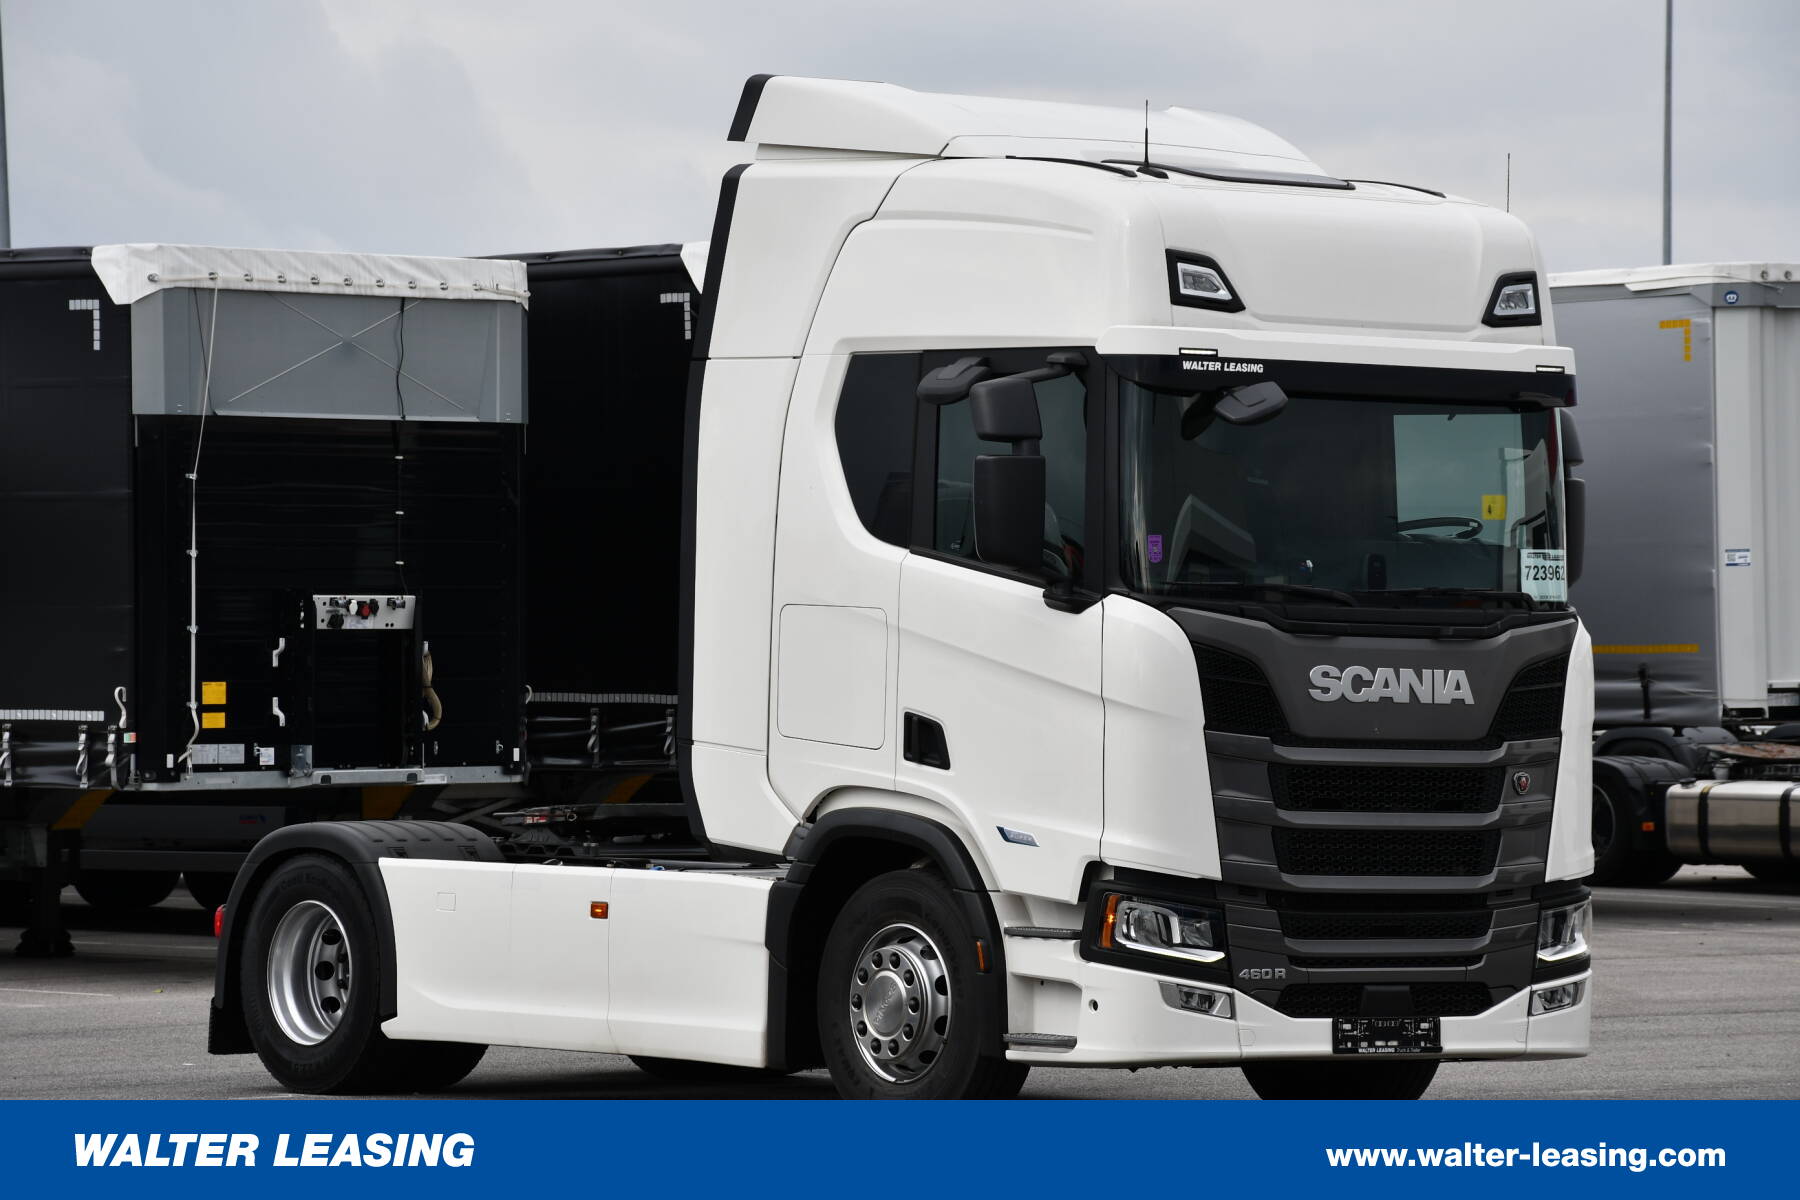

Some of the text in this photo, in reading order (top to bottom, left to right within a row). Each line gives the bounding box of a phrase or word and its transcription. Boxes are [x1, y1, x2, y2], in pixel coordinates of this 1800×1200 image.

[1182, 360, 1264, 373] WALTER LEASING
[1308, 664, 1475, 705] SCANIA
[1238, 968, 1286, 980] 460 R
